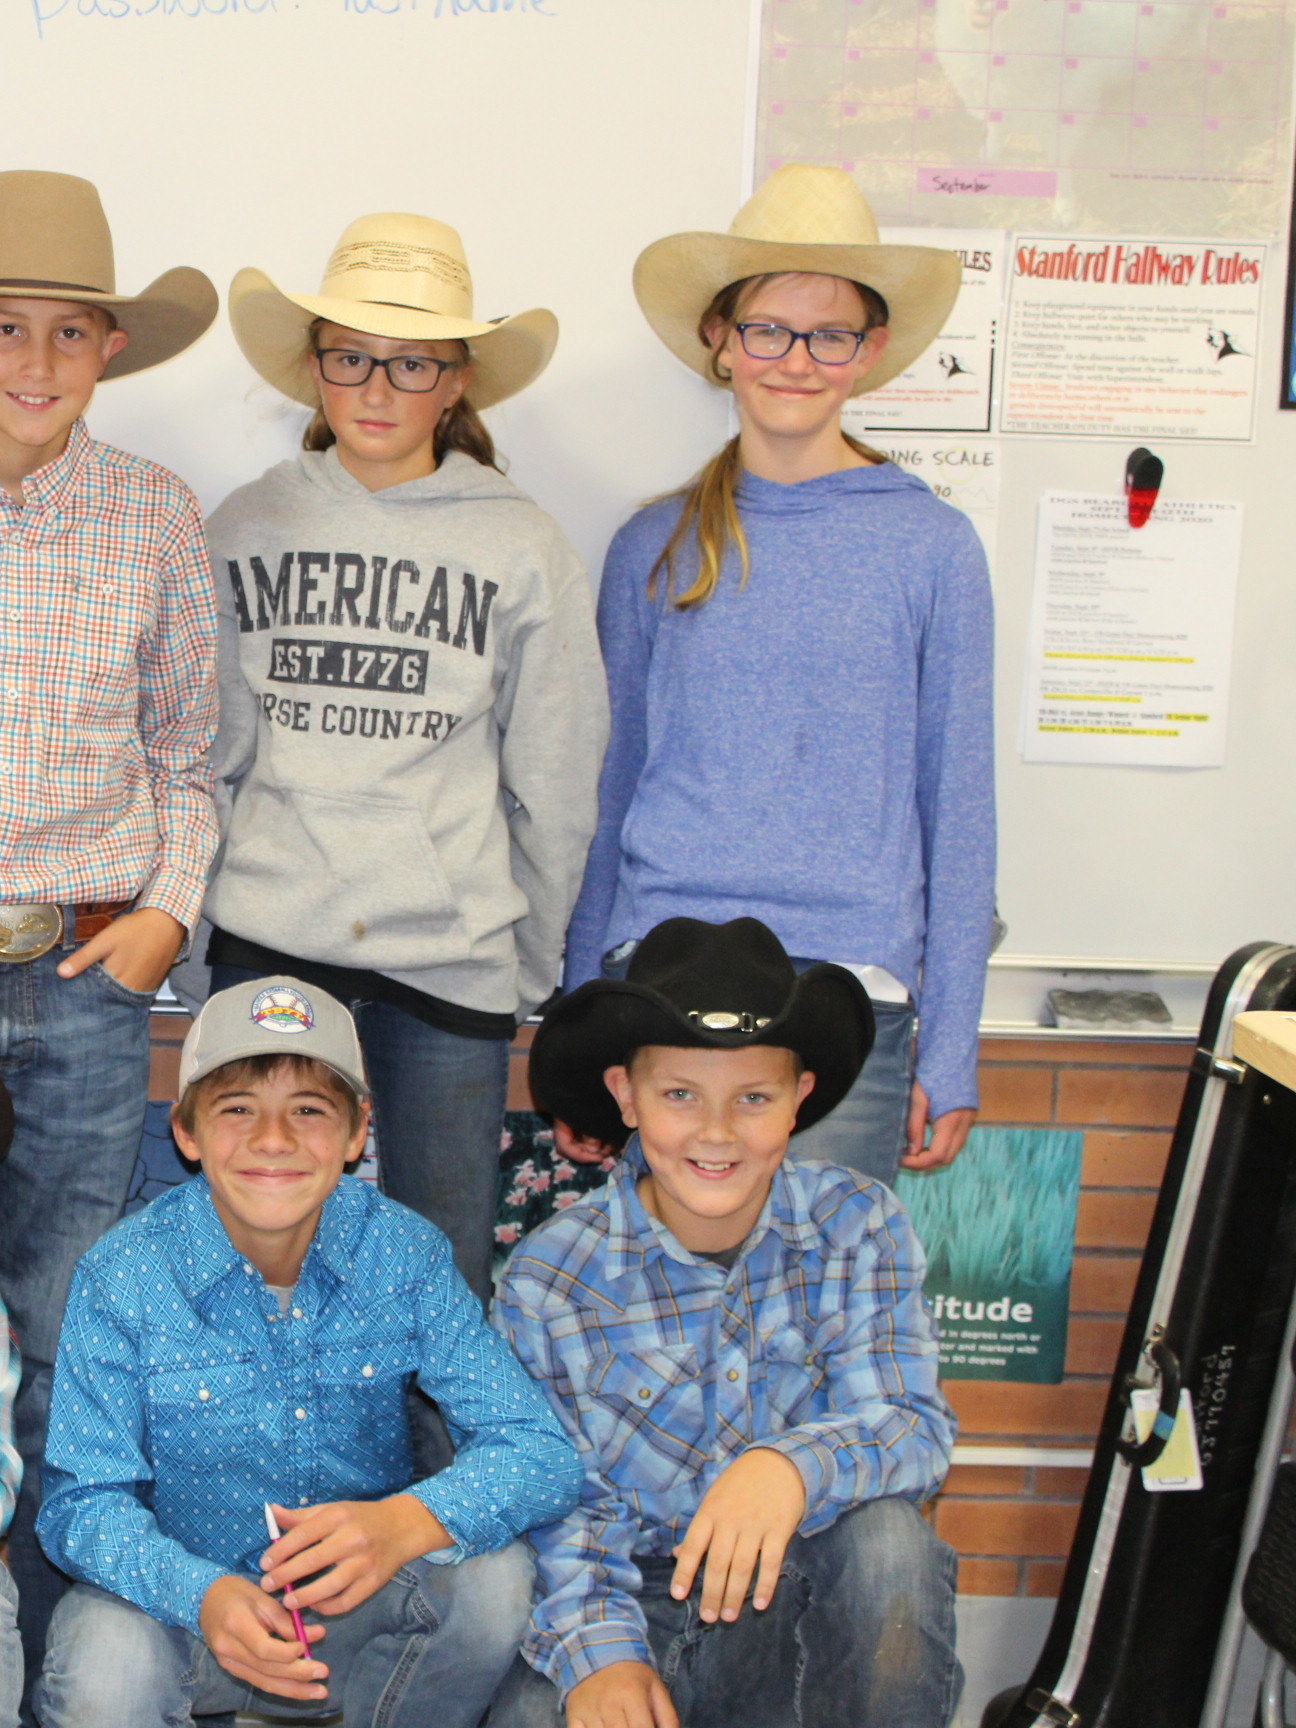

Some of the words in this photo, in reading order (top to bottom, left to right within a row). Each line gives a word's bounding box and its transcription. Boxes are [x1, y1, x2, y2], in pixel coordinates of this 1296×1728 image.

[933, 176, 990, 194] September
[1015, 244, 1109, 282] Stanford
[1112, 245, 1199, 286] Hallway
[1201, 250, 1260, 285] Rules
[933, 451, 994, 467] SCALE
[227, 551, 499, 656] AMERICAN
[274, 644, 421, 689] EST.1776
[255, 693, 311, 731] RSE
[322, 704, 462, 742] COUNTRY
[928, 1295, 1034, 1323] itude
[960, 1331, 998, 1340] degrees
[1000, 1332, 1027, 1341] north
[958, 1343, 976, 1351] and
[978, 1344, 1014, 1353] marked
[1016, 1345, 1038, 1354] with
[968, 1356, 1006, 1366] degrees
